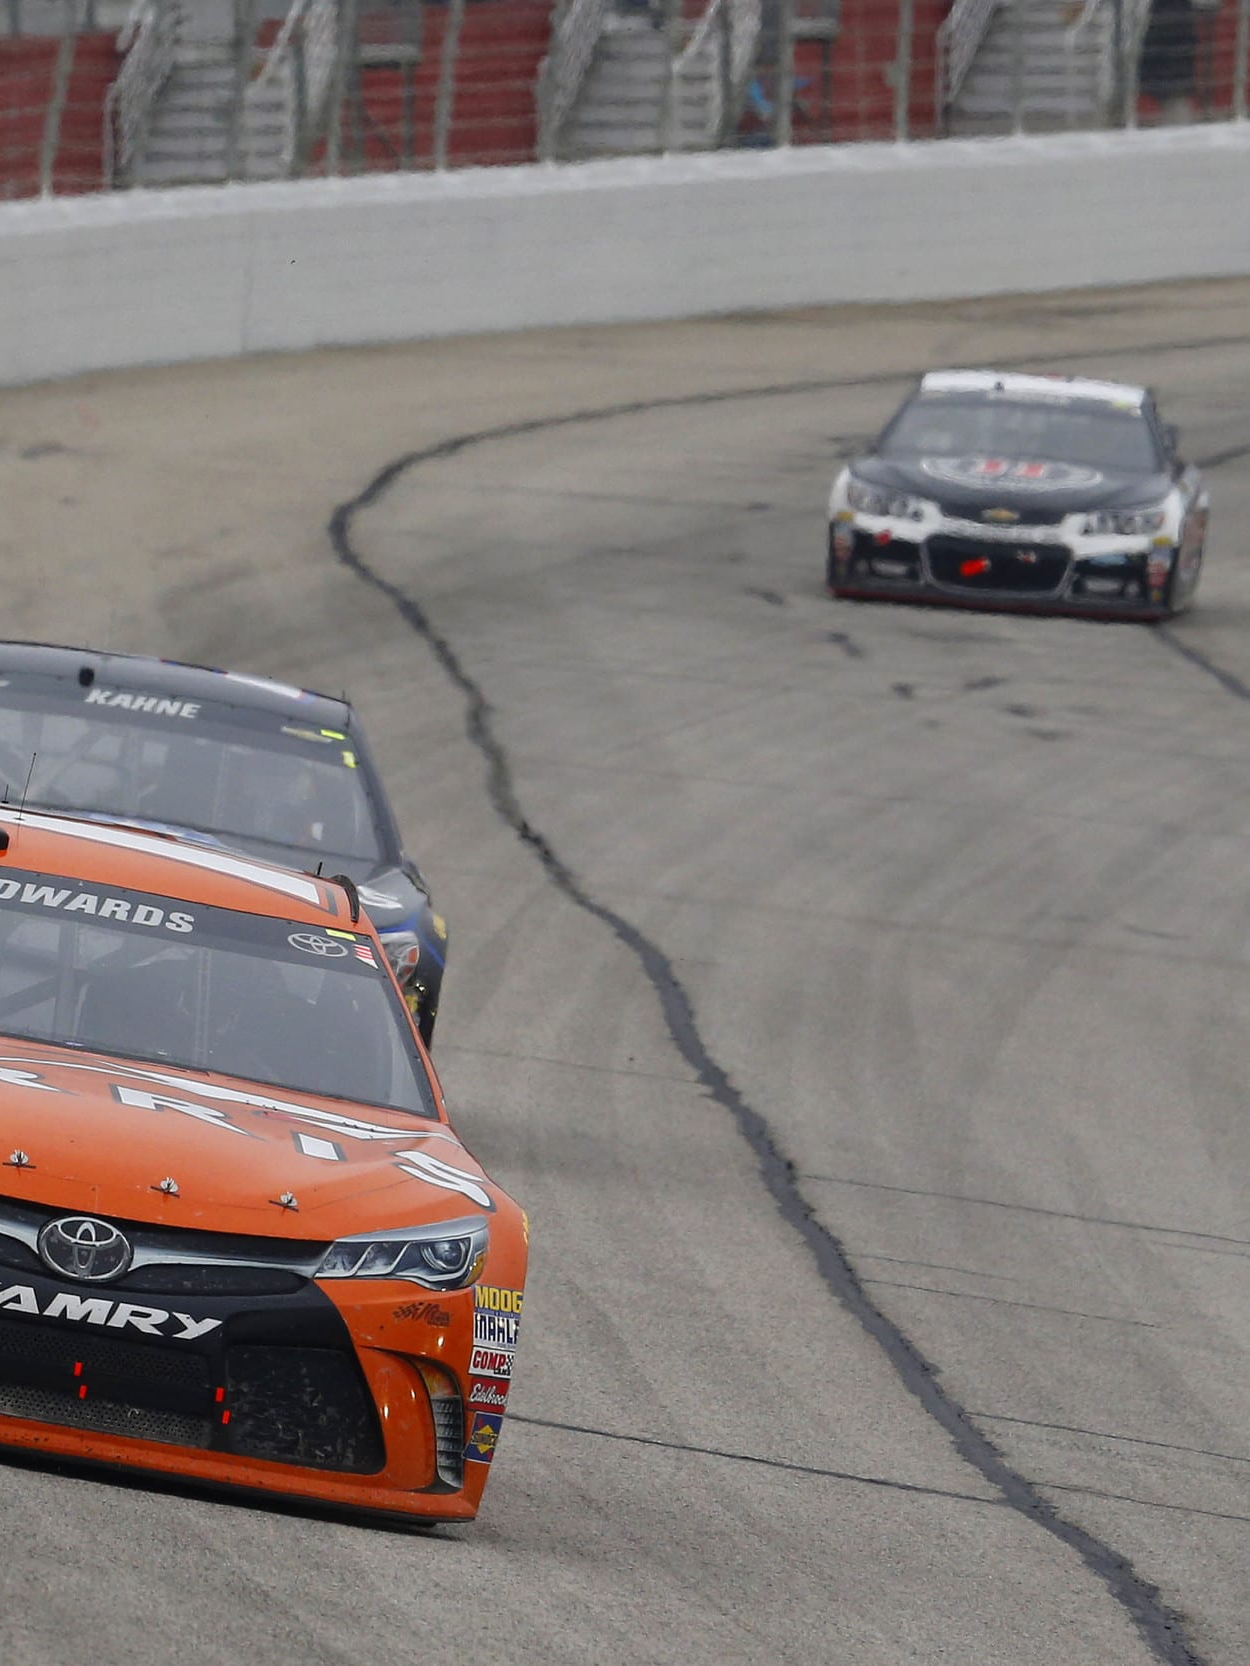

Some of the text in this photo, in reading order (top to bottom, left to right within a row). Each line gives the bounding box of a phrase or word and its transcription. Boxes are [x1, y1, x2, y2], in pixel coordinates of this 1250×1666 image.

[85, 688, 202, 719] KAHNE
[475, 1285, 524, 1314] MOOG
[473, 1350, 507, 1371] COMP
